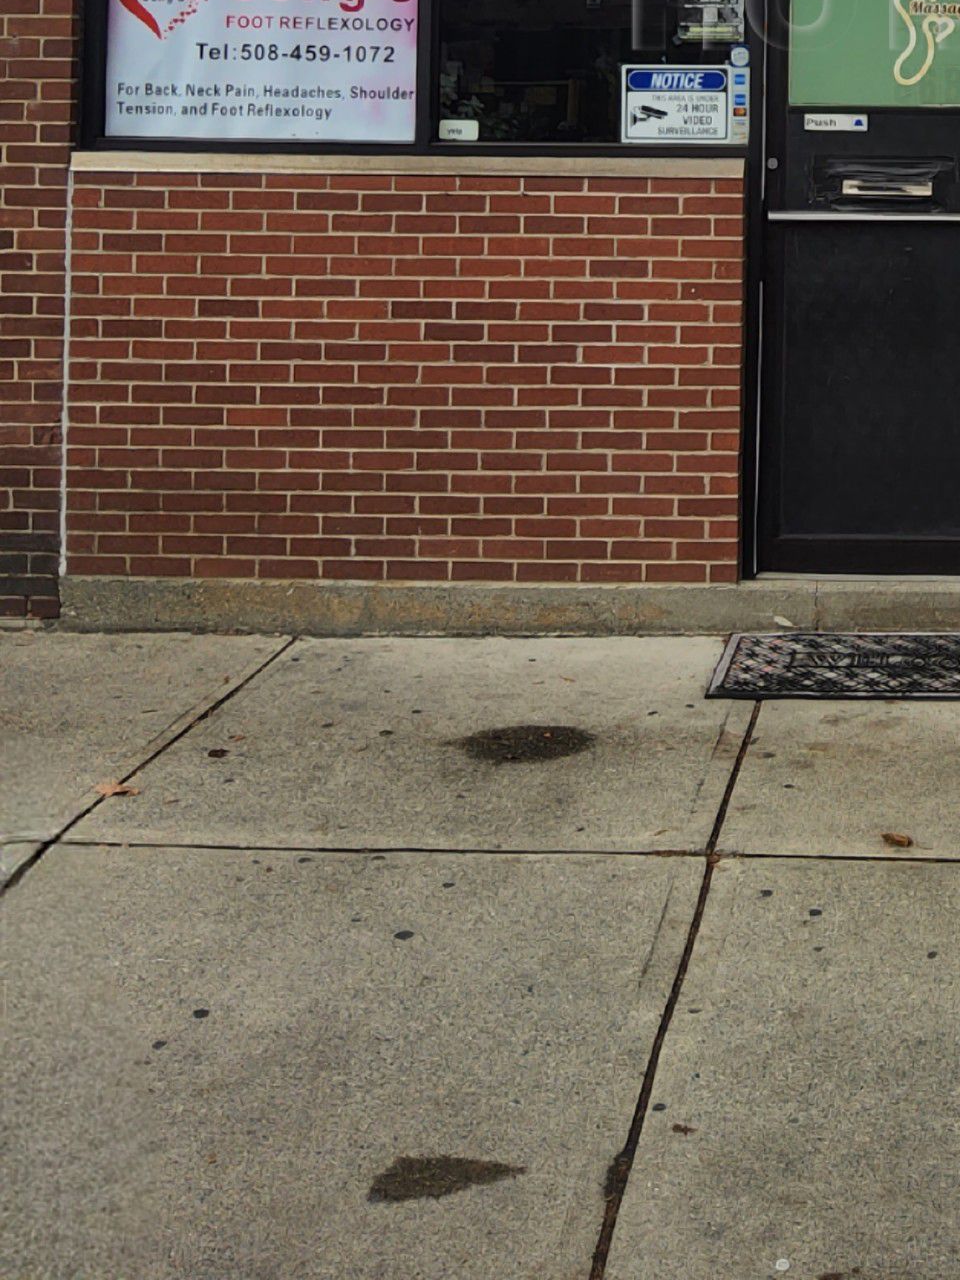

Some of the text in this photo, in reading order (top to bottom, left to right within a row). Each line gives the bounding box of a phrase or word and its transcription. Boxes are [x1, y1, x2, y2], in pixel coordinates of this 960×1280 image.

[226, 15, 415, 32] FOOT REFLEXOLOGY
[196, 43, 396, 63] Tel:508-459-1072
[651, 73, 705, 89] NOTICE
[117, 83, 140, 97] For
[186, 84, 221, 98] Neck
[225, 84, 259, 99] Pain,
[264, 85, 345, 100] Headaches,
[350, 86, 415, 101] Shoulder
[181, 102, 208, 116] and
[211, 102, 243, 116] Foot
[247, 103, 333, 120] Reflexology
[677, 104, 719, 113] 24 HOUR
[683, 116, 712, 125] VIDEO
[806, 117, 837, 127] Push
[658, 127, 719, 135] SURVEILLANCE
